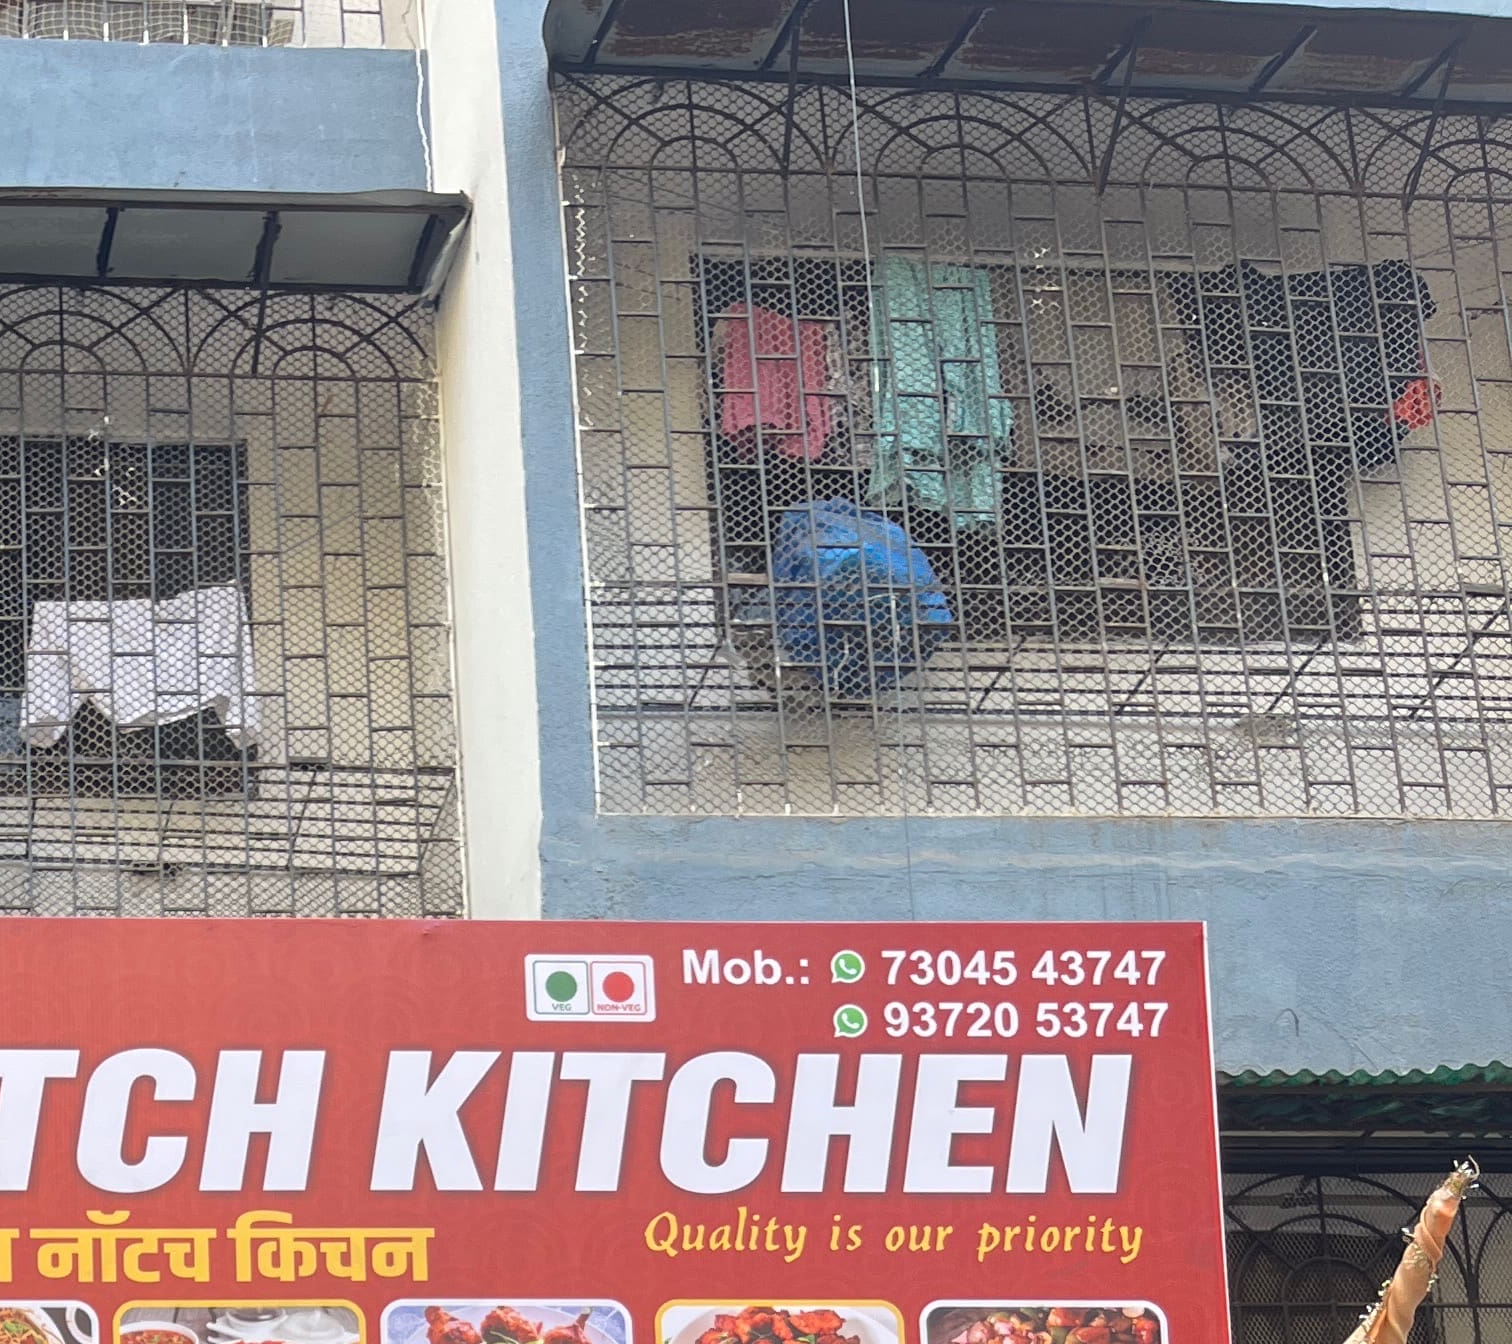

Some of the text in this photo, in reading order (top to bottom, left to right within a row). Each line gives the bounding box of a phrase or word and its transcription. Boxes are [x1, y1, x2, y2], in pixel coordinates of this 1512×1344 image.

[683, 949, 1165, 985] Mob.: 73045 43747
[552, 1003, 572, 1012] VEG
[597, 1003, 641, 1012] NON-VEG
[884, 1002, 1168, 1037] 93720 53747
[370, 1051, 1132, 1193] KITCHEN
[30, 1210, 217, 1282] नॉटच
[227, 1210, 435, 1282] किचन
[645, 1208, 1143, 1263] Quality is our priority
